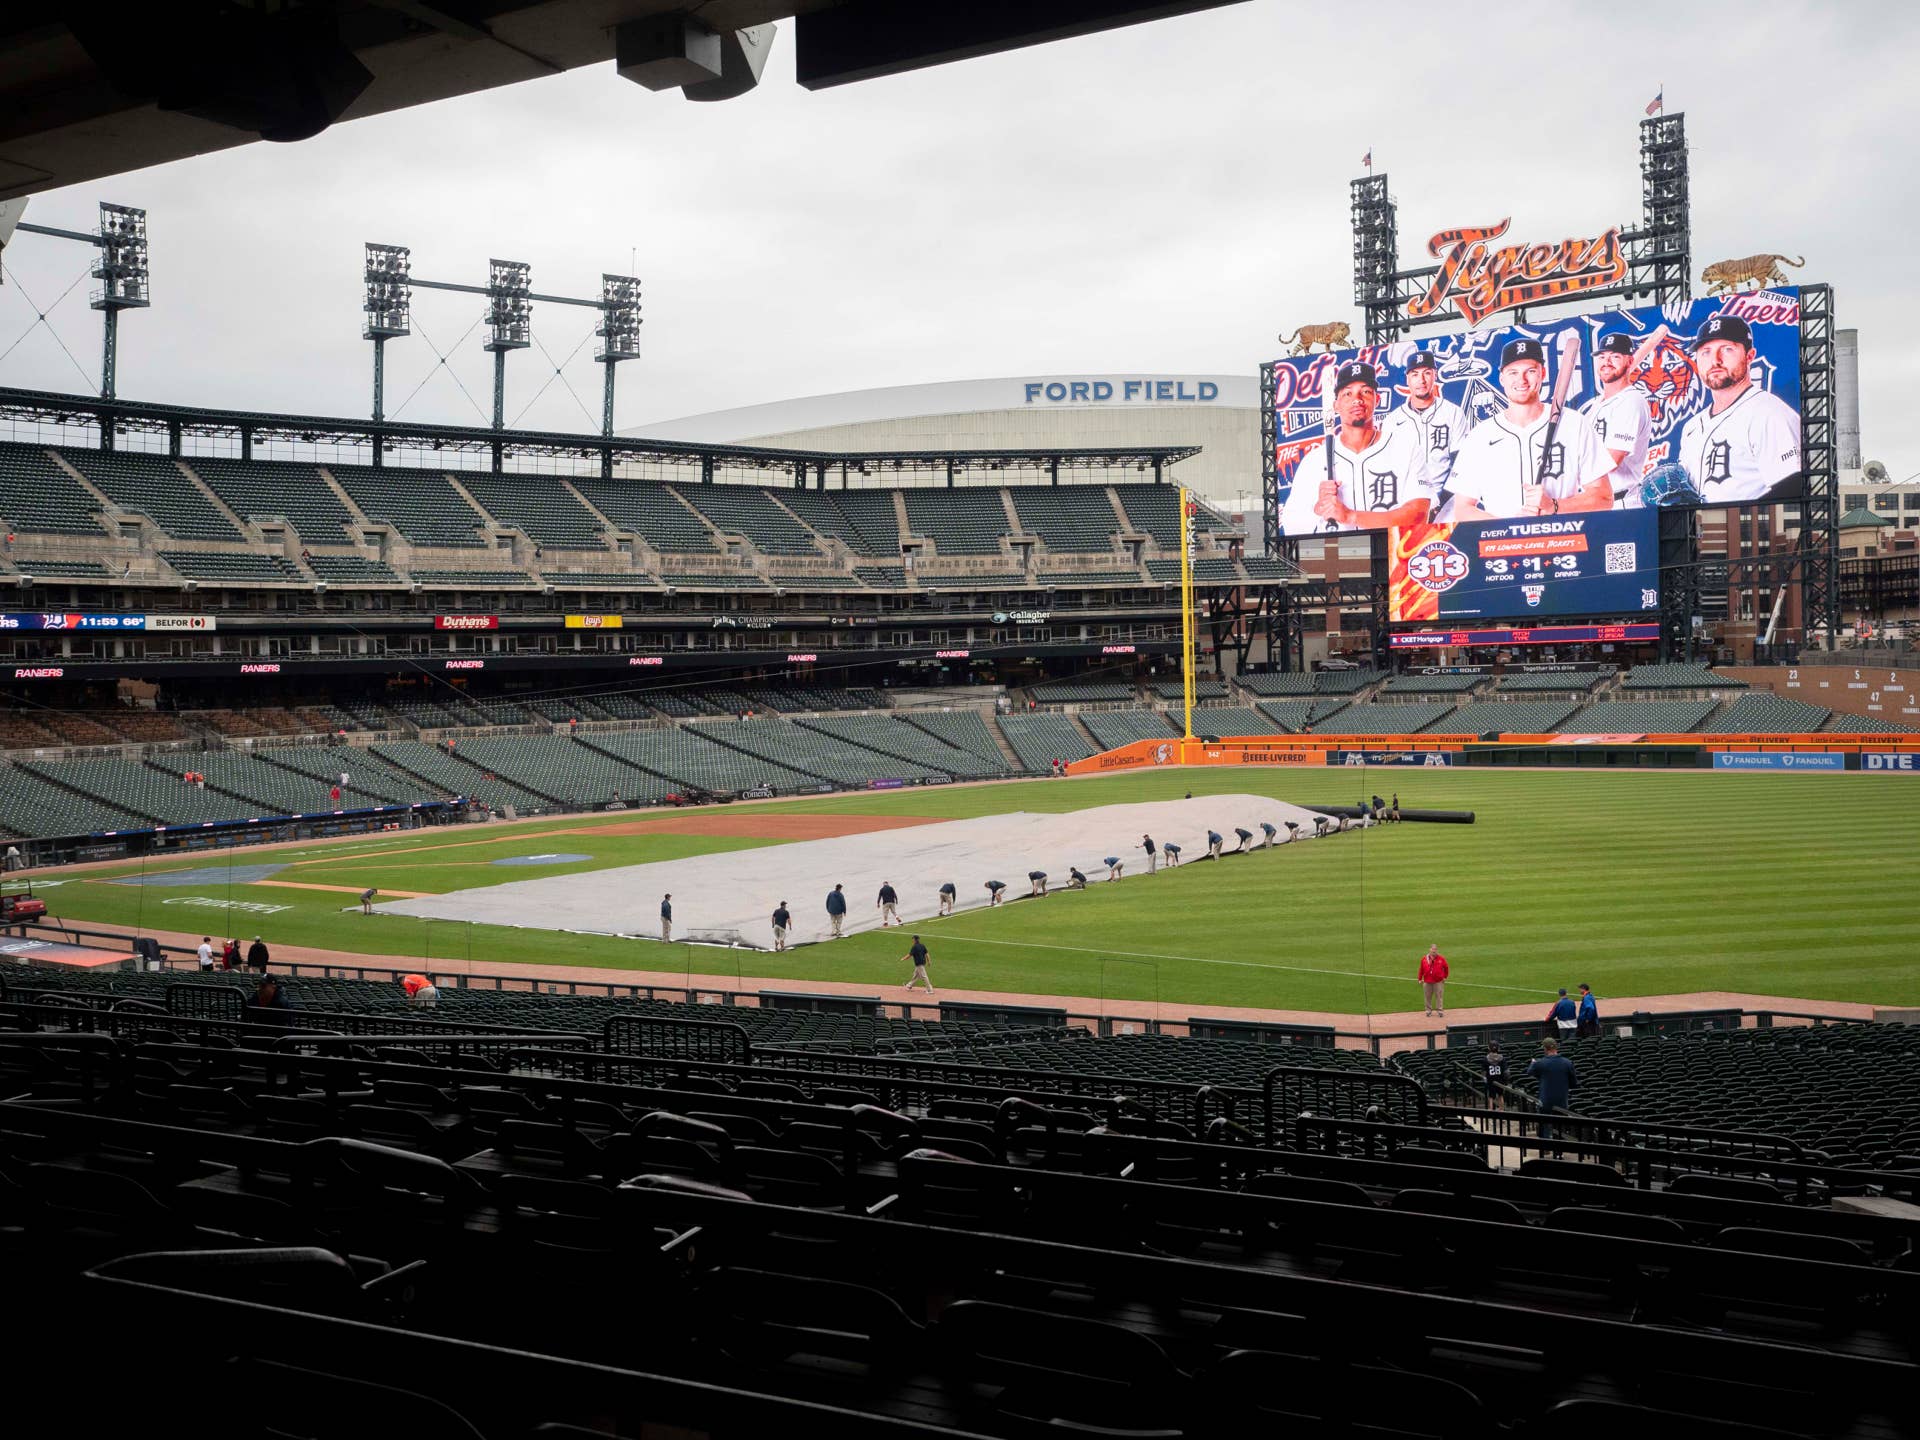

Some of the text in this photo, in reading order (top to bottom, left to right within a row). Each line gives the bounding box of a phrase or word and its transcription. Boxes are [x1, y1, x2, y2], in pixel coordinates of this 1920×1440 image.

[1408, 217, 1628, 327] Tigers
[1760, 292, 1796, 306] DETROIT
[1024, 380, 1219, 403] FORD FIELD
[1614, 432, 1635, 442] meijer
[1278, 444, 1299, 464] THE
[1480, 520, 1584, 538] EVERY TUESDAY
[1424, 543, 1450, 553] VALUE
[1410, 554, 1466, 578] 313
[1485, 558, 1508, 573] $3
[1522, 557, 1541, 571] $1
[1553, 555, 1577, 569] $3
[1425, 579, 1451, 589] GAMES
[737, 616, 778, 624] CHAMPIONS
[1009, 611, 1050, 619] Gallagher
[81, 617, 119, 626] 11:59
[122, 617, 144, 626] 66°
[156, 619, 188, 627] BELFOR
[443, 616, 490, 626] Dunham's
[1417, 636, 1444, 644] Mortgage
[1789, 669, 1798, 679] 23
[1855, 669, 1860, 680] 5
[1890, 672, 1896, 682] 2
[1871, 691, 1880, 702] 47
[1909, 694, 1915, 705] 3
[1868, 754, 1913, 769] DTE
[1489, 1065, 1501, 1076] 28
